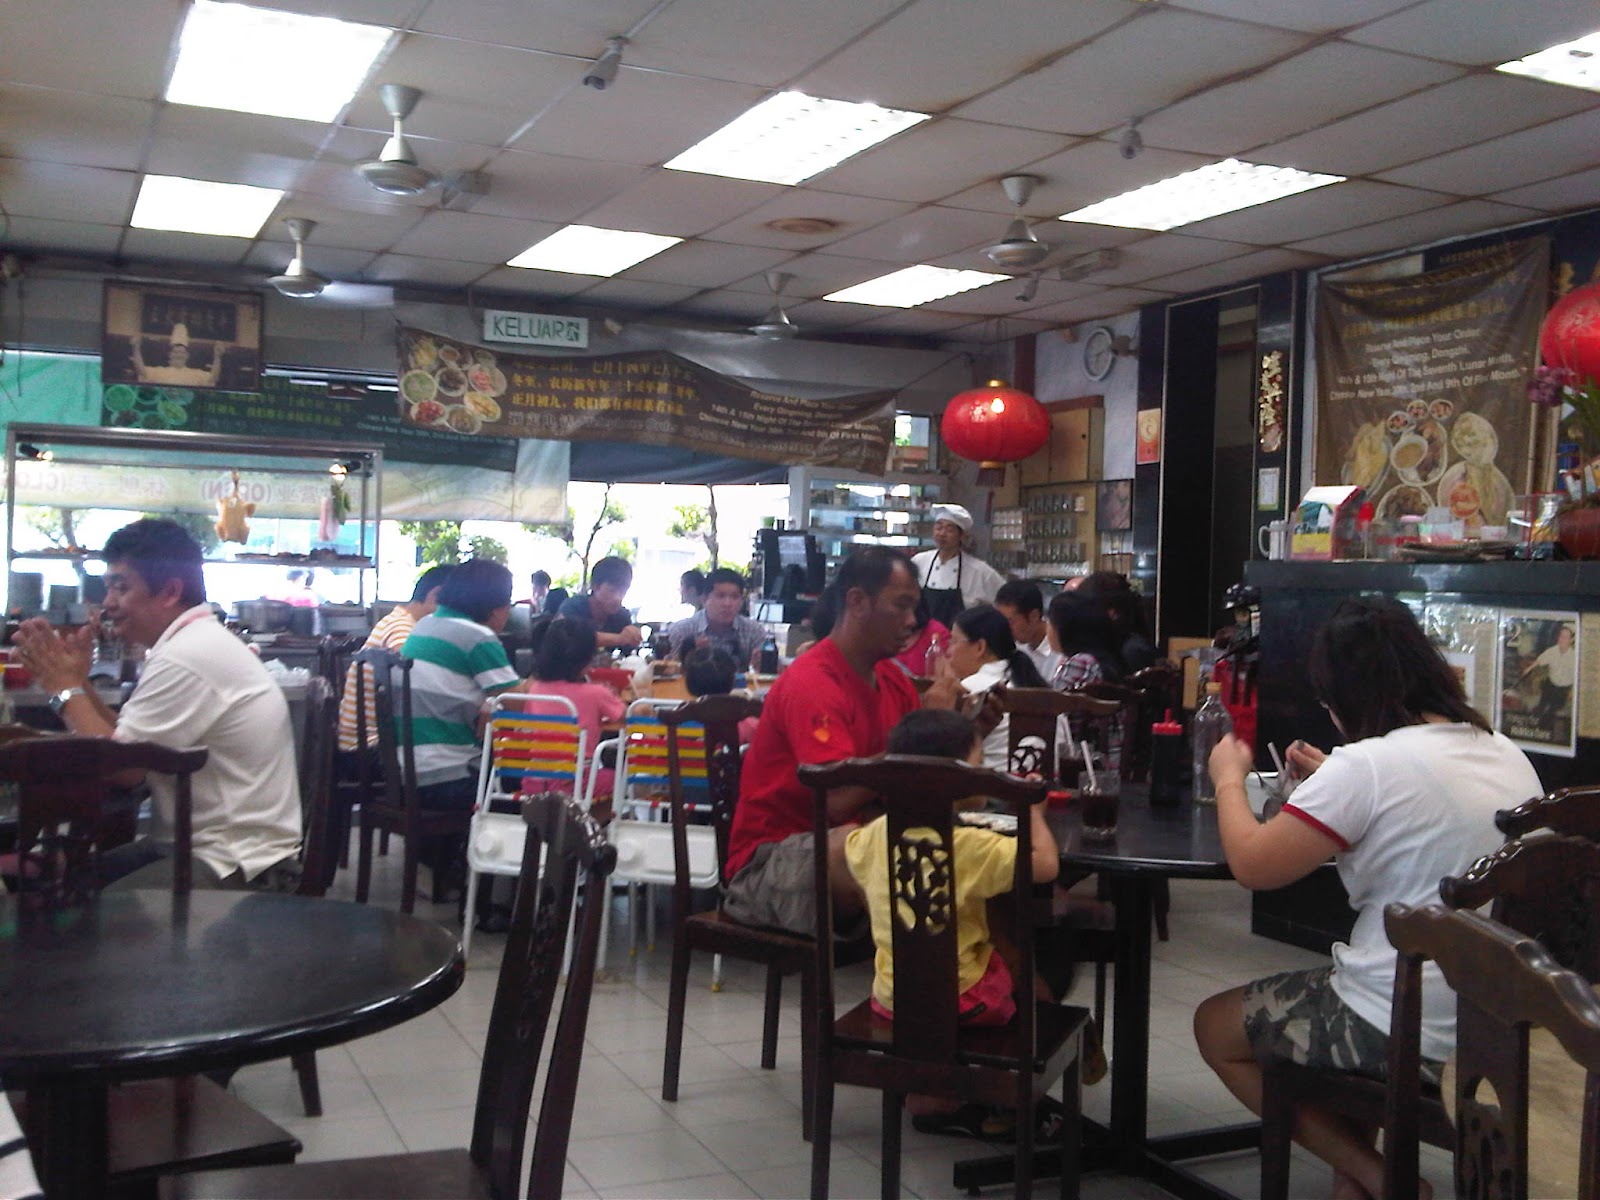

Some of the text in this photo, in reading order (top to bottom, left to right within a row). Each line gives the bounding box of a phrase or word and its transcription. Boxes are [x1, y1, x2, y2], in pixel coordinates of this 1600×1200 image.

[494, 314, 565, 339] KELUAR
[1432, 332, 1452, 342] Your
[1354, 375, 1361, 384] &
[1408, 367, 1421, 378] The
[1423, 362, 1457, 376] Seventh
[1459, 359, 1486, 371] Lunar
[1358, 388, 1374, 398] New
[1426, 380, 1444, 391] And
[1445, 377, 1460, 388] 9th
[1462, 375, 1474, 386] Of
[729, 408, 736, 416] &
[777, 416, 787, 424] Of
[788, 417, 802, 426] The
[753, 402, 775, 413] Every
[357, 422, 385, 432] Chinese
[699, 412, 730, 426] Chinese
[731, 420, 749, 430] New
[750, 423, 767, 432] Year
[830, 431, 840, 440] Of
[841, 431, 859, 440] First
